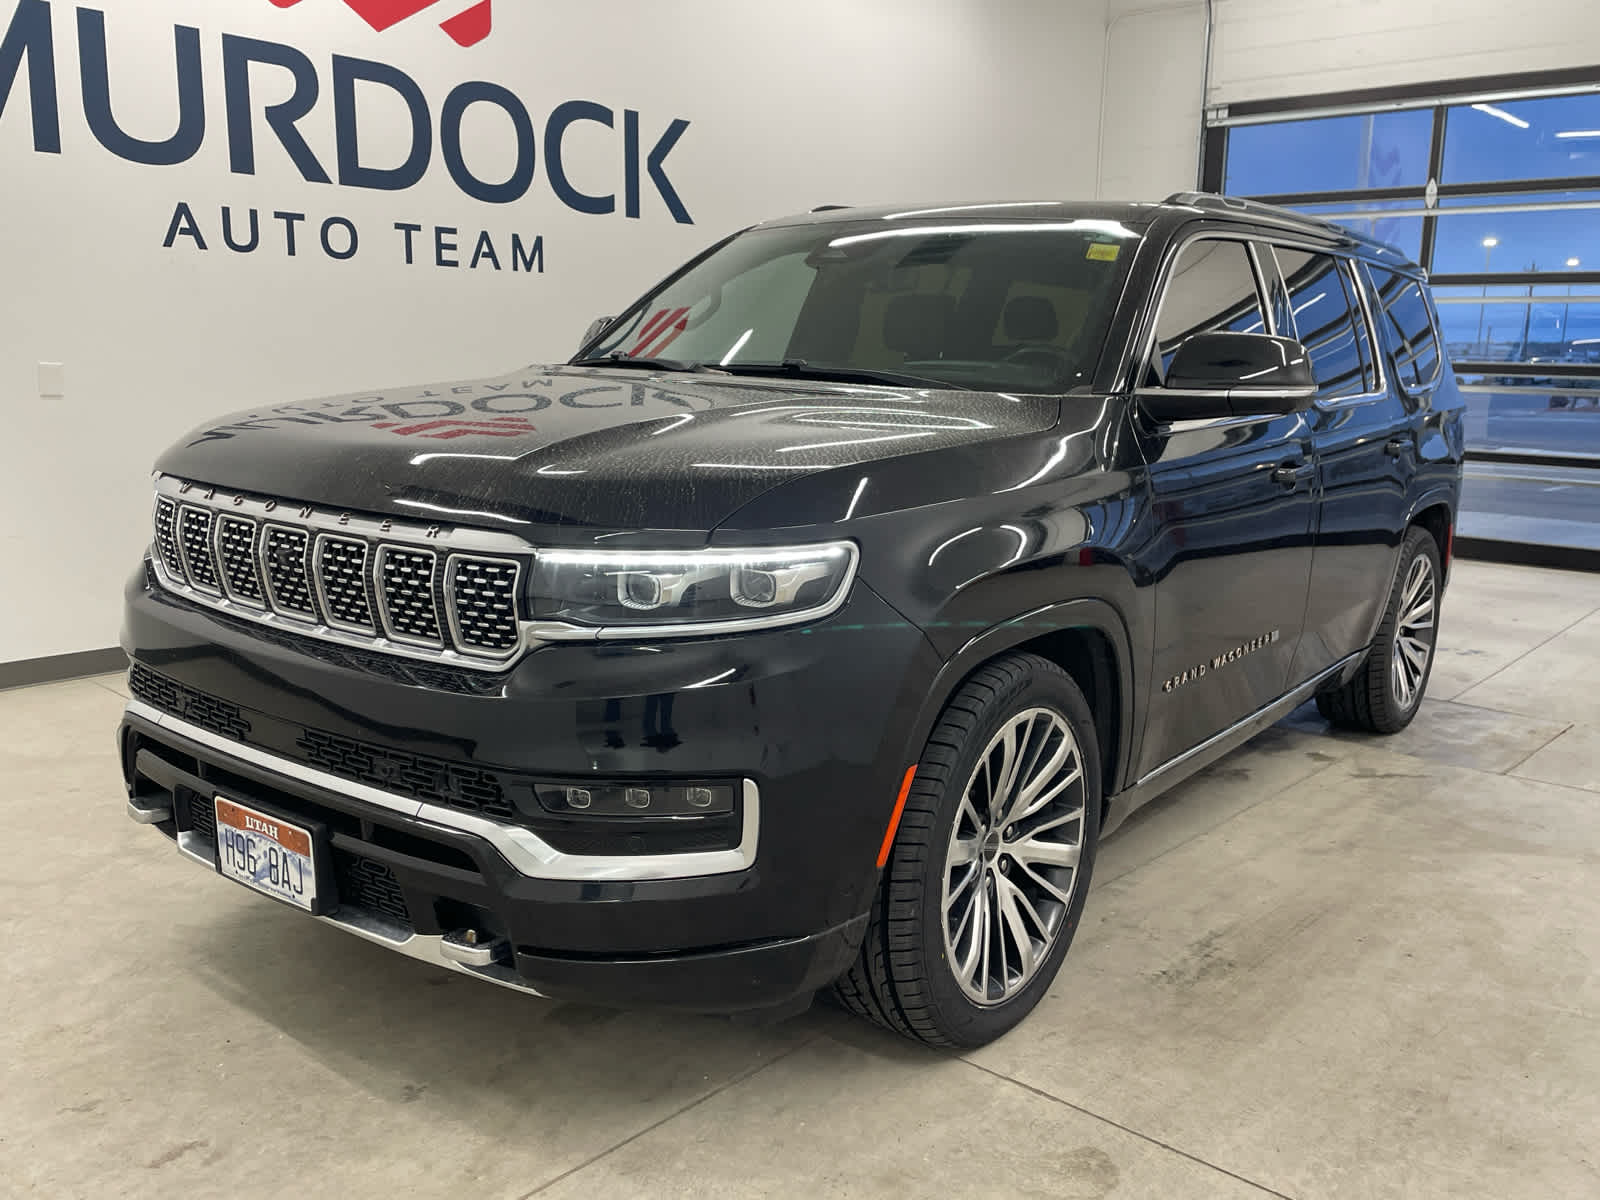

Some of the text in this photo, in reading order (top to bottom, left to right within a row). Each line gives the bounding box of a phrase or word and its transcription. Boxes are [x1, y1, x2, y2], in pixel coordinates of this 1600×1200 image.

[162, 202, 545, 273] AUTO TEAM
[178, 480, 441, 539] WAGONEER
[1165, 664, 1206, 692] GRAND
[1213, 633, 1270, 669] WAGONEER
[244, 815, 279, 840] UTAH
[225, 828, 257, 876] H96
[268, 846, 303, 895] 8AJ
